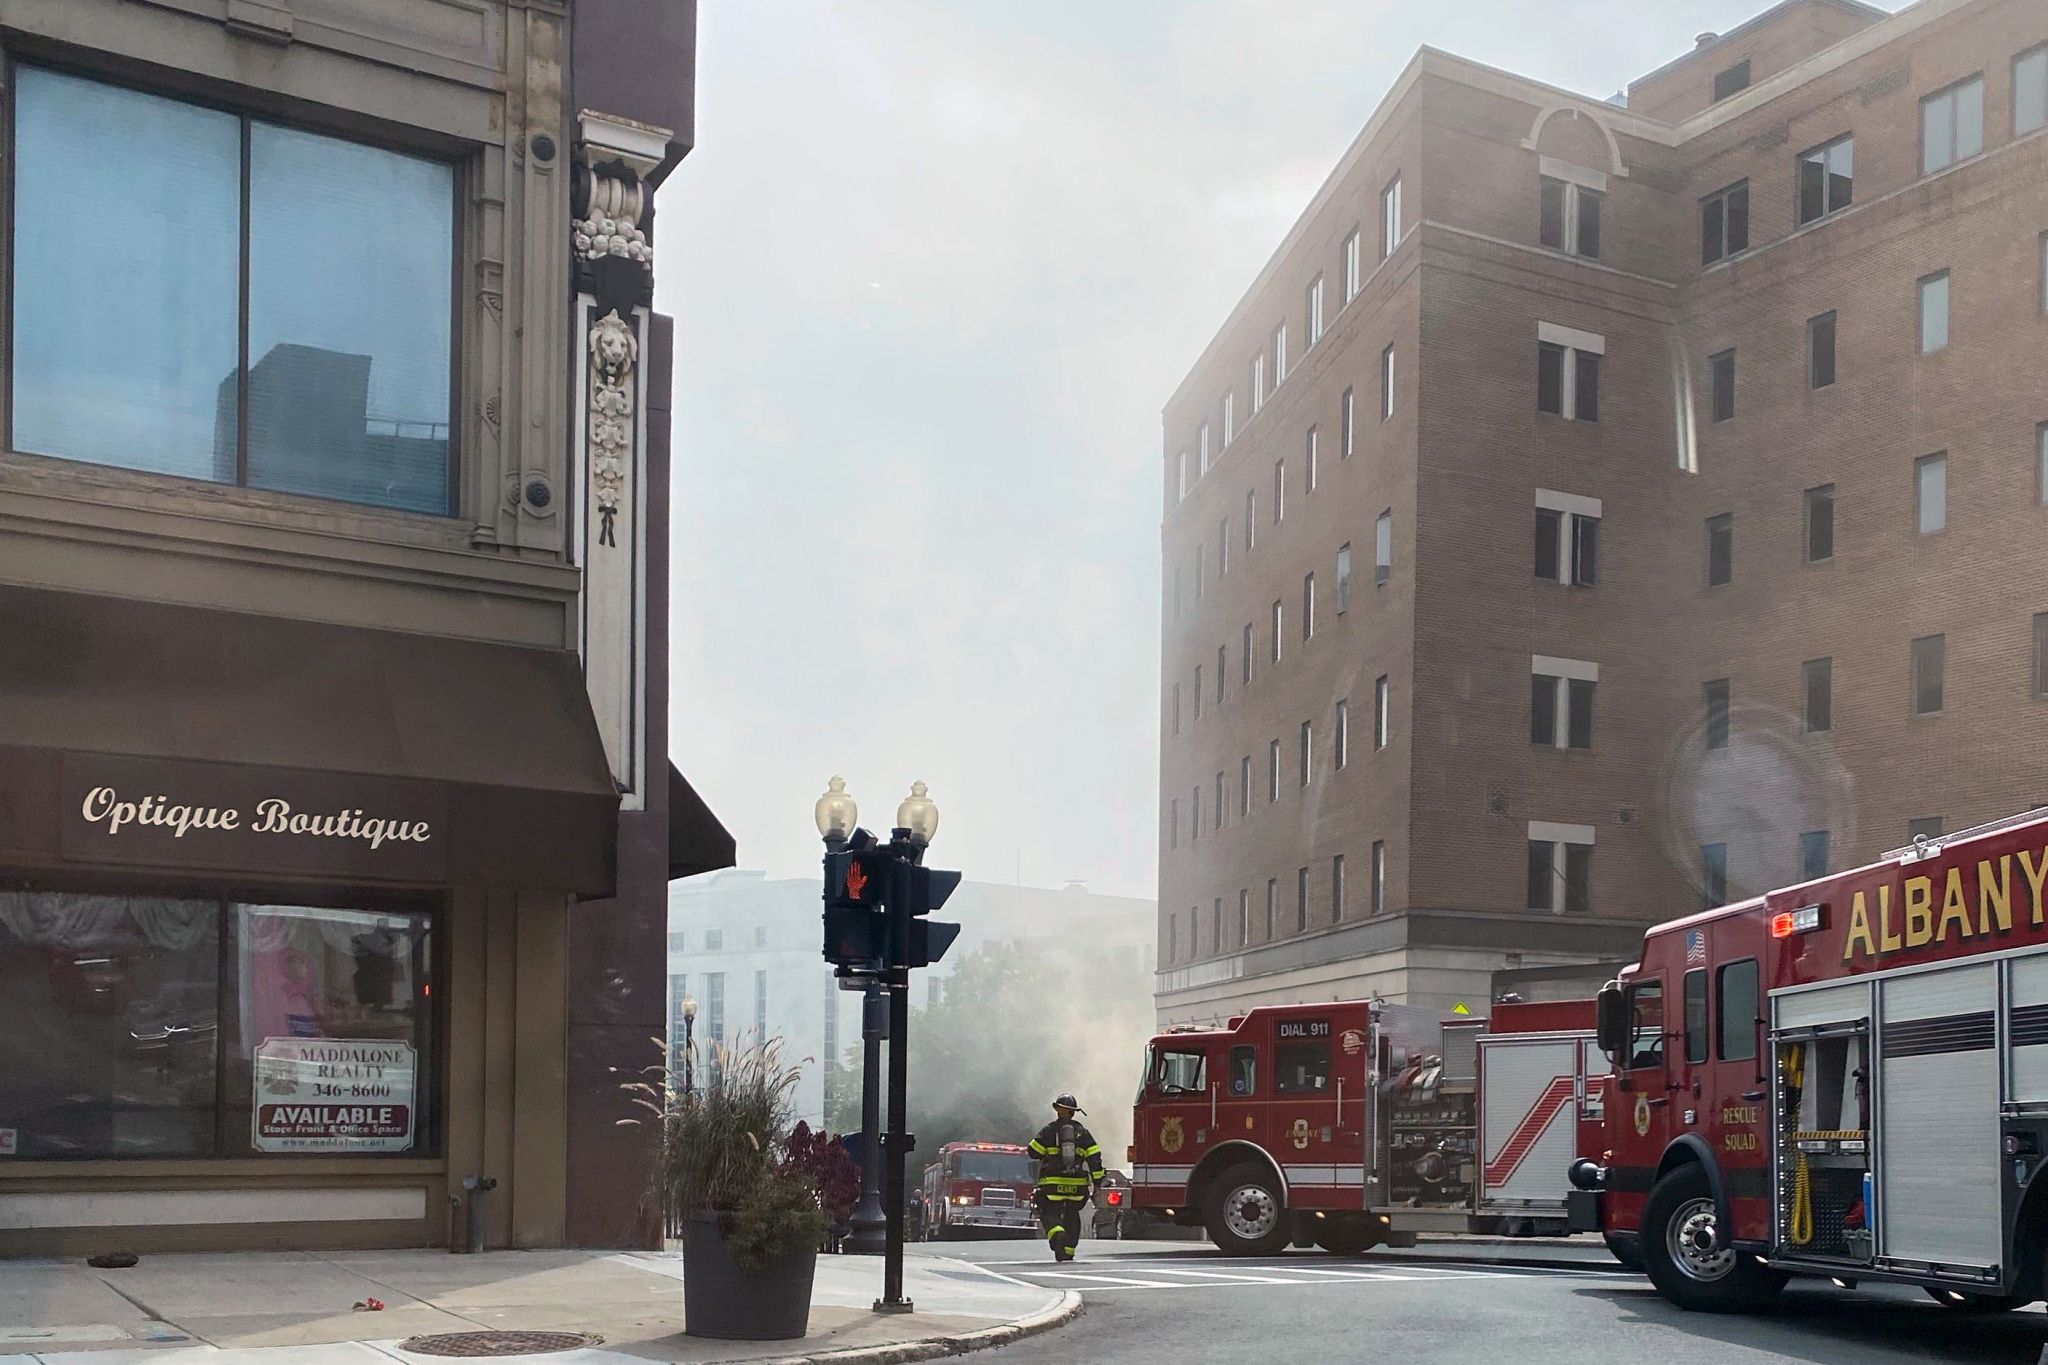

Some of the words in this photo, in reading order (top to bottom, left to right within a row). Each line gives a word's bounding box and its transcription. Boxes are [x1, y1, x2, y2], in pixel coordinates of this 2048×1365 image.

[82, 787, 239, 838] Optique
[251, 798, 431, 850] Boutique
[1843, 845, 2048, 959] ALBANY
[1280, 1023, 1307, 1037] DIAL
[1310, 1022, 1329, 1036] 911
[300, 1048, 404, 1064] MADDALONE
[317, 1064, 385, 1078] REALTY
[312, 1082, 390, 1097] 346-8600
[271, 1107, 393, 1124] AVAILABLE
[1723, 1106, 1757, 1124] RESCUE
[263, 1124, 292, 1134] Store
[295, 1124, 324, 1133] Front
[328, 1124, 336, 1133] &
[339, 1124, 369, 1133] Office
[372, 1124, 402, 1135] Space
[1724, 1133, 1756, 1150] SQUAD
